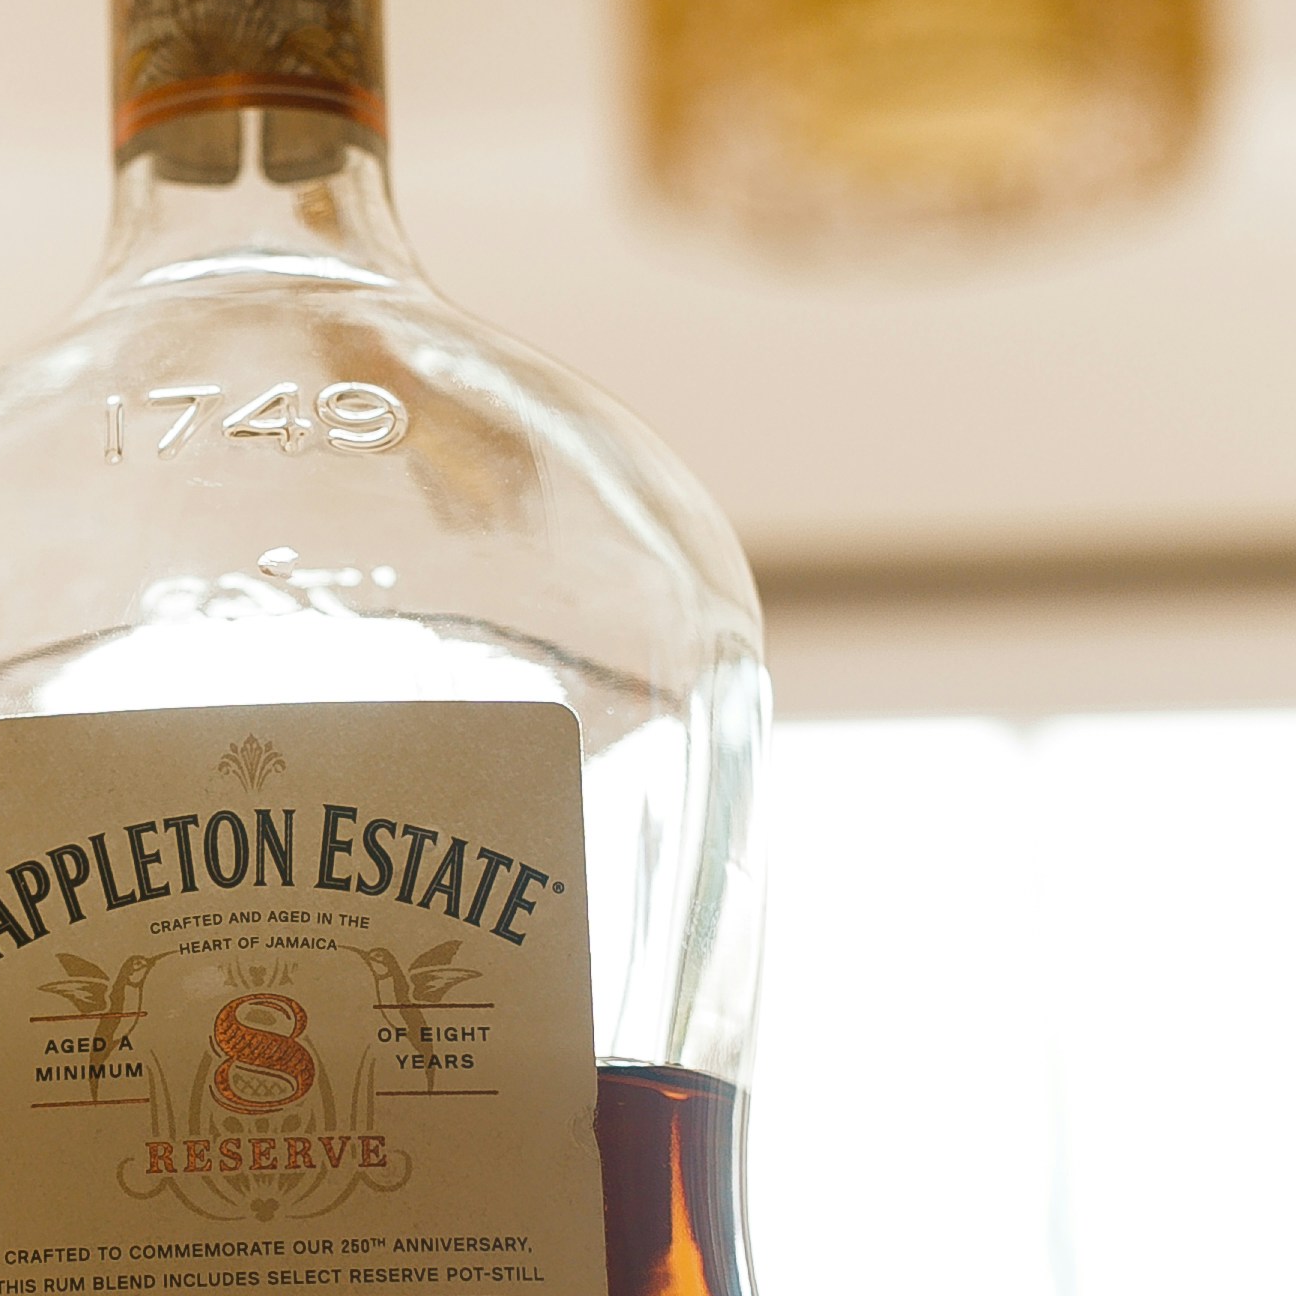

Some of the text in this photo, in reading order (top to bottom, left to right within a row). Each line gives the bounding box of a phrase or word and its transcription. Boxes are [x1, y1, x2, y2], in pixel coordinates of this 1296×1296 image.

[105, 381, 408, 464] 1749
[149, 910, 371, 935] CRAFTED AND AGED IN THE
[179, 936, 338, 955] HEART OF JAMAICA
[44, 1035, 134, 1056] AGED A
[377, 1025, 491, 1044] OF EIGHT
[212, 992, 316, 1116] 8
[395, 1051, 475, 1070] YEARS
[35, 1061, 144, 1083] MINIMUM
[145, 1135, 388, 1175] RESERVE
[4, 1247, 91, 1265] CRAFTED
[97, 1245, 122, 1261] TO
[129, 1240, 285, 1260] COMMEMORATE
[292, 1239, 334, 1255] OUR
[393, 1236, 533, 1254] ANNIVERSARY,
[44, 1277, 85, 1293] RUM
[92, 1274, 156, 1291] BLEND
[163, 1271, 260, 1289] INCLUDES
[267, 1269, 342, 1285] SELECT
[349, 1267, 439, 1284] RESERVE
[446, 1266, 545, 1282] POT-STILL
